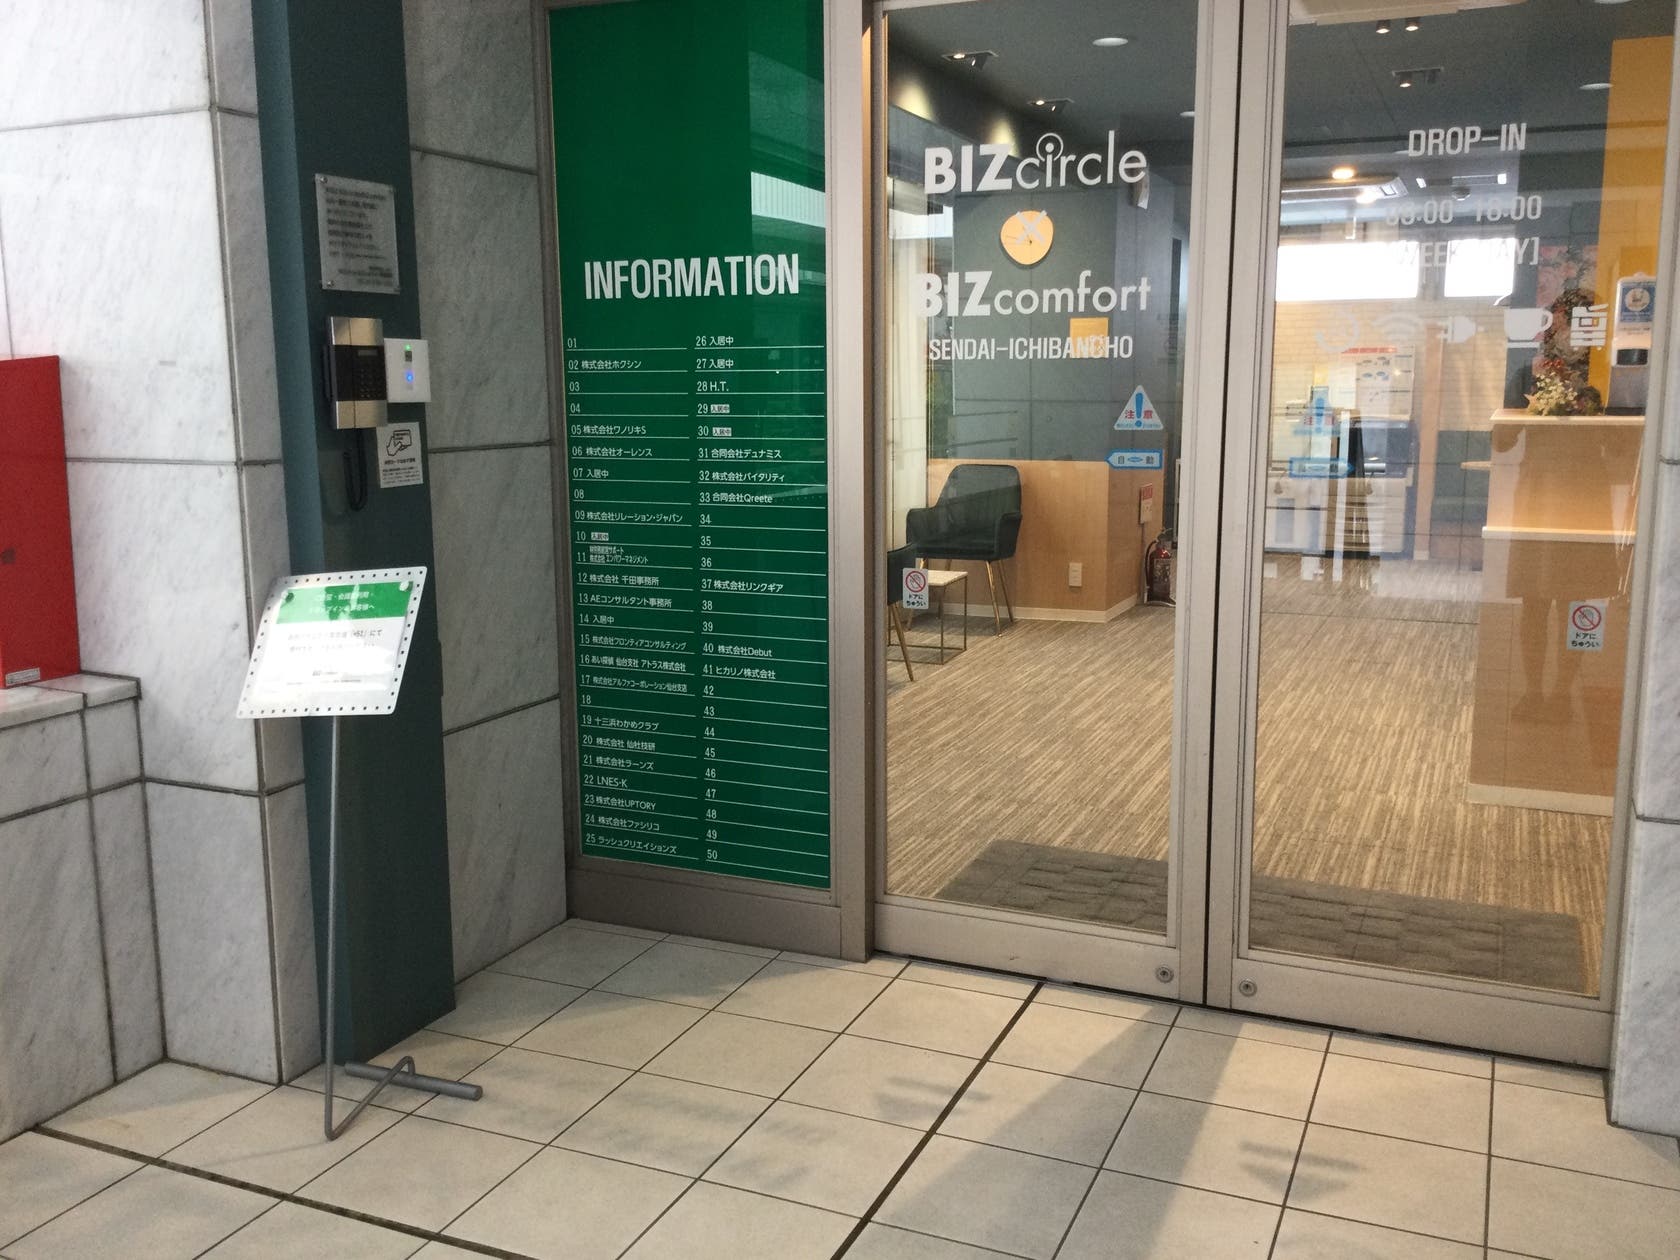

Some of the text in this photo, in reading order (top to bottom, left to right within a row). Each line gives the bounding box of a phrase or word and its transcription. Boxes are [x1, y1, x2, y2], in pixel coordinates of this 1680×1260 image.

[1408, 123, 1527, 157] DROP-IN
[584, 253, 799, 299] INFORMATION
[567, 338, 577, 348] 01
[696, 336, 734, 346] 26 入居中
[929, 335, 1133, 361] SENDAI-ICHIBANCHO
[568, 359, 642, 370] 02 株式会社ホクシン
[696, 359, 734, 369] 27 入居中
[569, 381, 580, 392] 03
[697, 381, 729, 391] 28 H.T.
[570, 403, 581, 413] 04
[697, 404, 708, 414] 29
[571, 424, 581, 435] 05
[698, 426, 709, 436] 30
[572, 446, 653, 457] 06 株式会社オーレンス
[698, 448, 782, 459] 31 合同会社デュナミス
[573, 468, 609, 479] 07 入居中
[699, 470, 785, 482] 32 株式会社バイタリティ
[574, 488, 584, 499] 08
[699, 492, 710, 503] 33
[575, 510, 585, 520] 09
[700, 514, 711, 524] 34
[576, 531, 586, 541] 10
[701, 536, 711, 546] 35
[577, 552, 587, 562] 11
[701, 557, 712, 567] 36
[578, 572, 588, 583] 12
[589, 574, 619, 584] 株式会社
[701, 579, 784, 593] 37 株式会社リンクギア
[579, 593, 672, 608] 13 AEコンサルタント事務所
[702, 600, 713, 610] 38
[580, 613, 615, 624] 14 入居中
[702, 621, 713, 632] 39
[580, 634, 590, 644] 15
[1576, 632, 1596, 640] ドアに
[703, 643, 773, 657] 40 株式会社Debut
[581, 654, 590, 664] 16
[703, 664, 776, 680] 41 ヒカリノ株式会社
[581, 674, 590, 684] 17
[704, 685, 714, 696] 42
[582, 694, 592, 704] 18
[704, 706, 715, 716] 43
[582, 714, 592, 725] 19
[704, 727, 715, 737] 44
[583, 734, 593, 744] 20
[596, 737, 624, 748] 株式会社
[705, 748, 716, 758] 45
[583, 754, 654, 771] 21 株式会社ラーンズ
[705, 768, 716, 778] 46
[584, 774, 594, 784] 22
[705, 788, 716, 798] 47
[585, 794, 656, 811] 23 株式会社UPTORY
[706, 809, 717, 819] 48
[585, 814, 660, 831] 24 株式会社ファシリコ
[586, 833, 596, 843] 25
[707, 829, 718, 840] 49
[707, 849, 718, 860] 50
